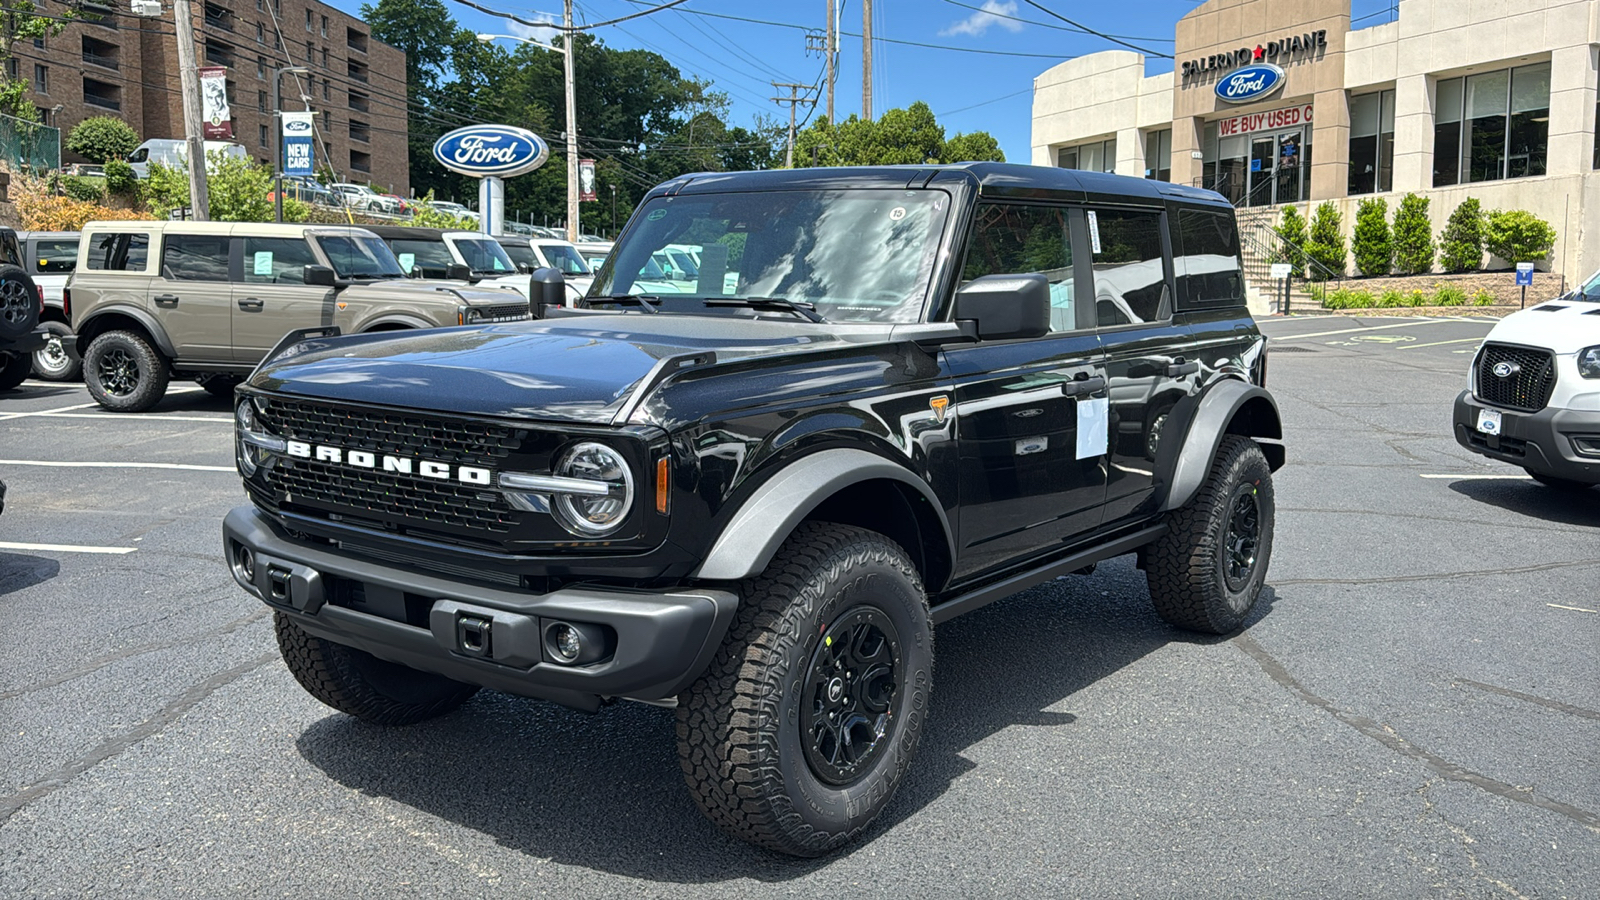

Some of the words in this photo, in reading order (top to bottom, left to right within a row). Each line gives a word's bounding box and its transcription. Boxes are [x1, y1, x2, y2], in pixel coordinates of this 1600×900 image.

[1181, 48, 1252, 76] SALERNO
[1267, 30, 1328, 57] DUANE
[1227, 72, 1264, 97] Ford
[289, 122, 307, 130] Ford
[1220, 119, 1238, 135] WE
[1241, 113, 1265, 132] BUY
[1268, 108, 1300, 128] USED
[287, 143, 310, 157] NEW
[455, 135, 518, 163] Ford
[287, 157, 310, 169] CARS
[893, 209, 904, 218] 15
[287, 440, 491, 485] BRONCO
[847, 669, 927, 819] GOODYEAR
